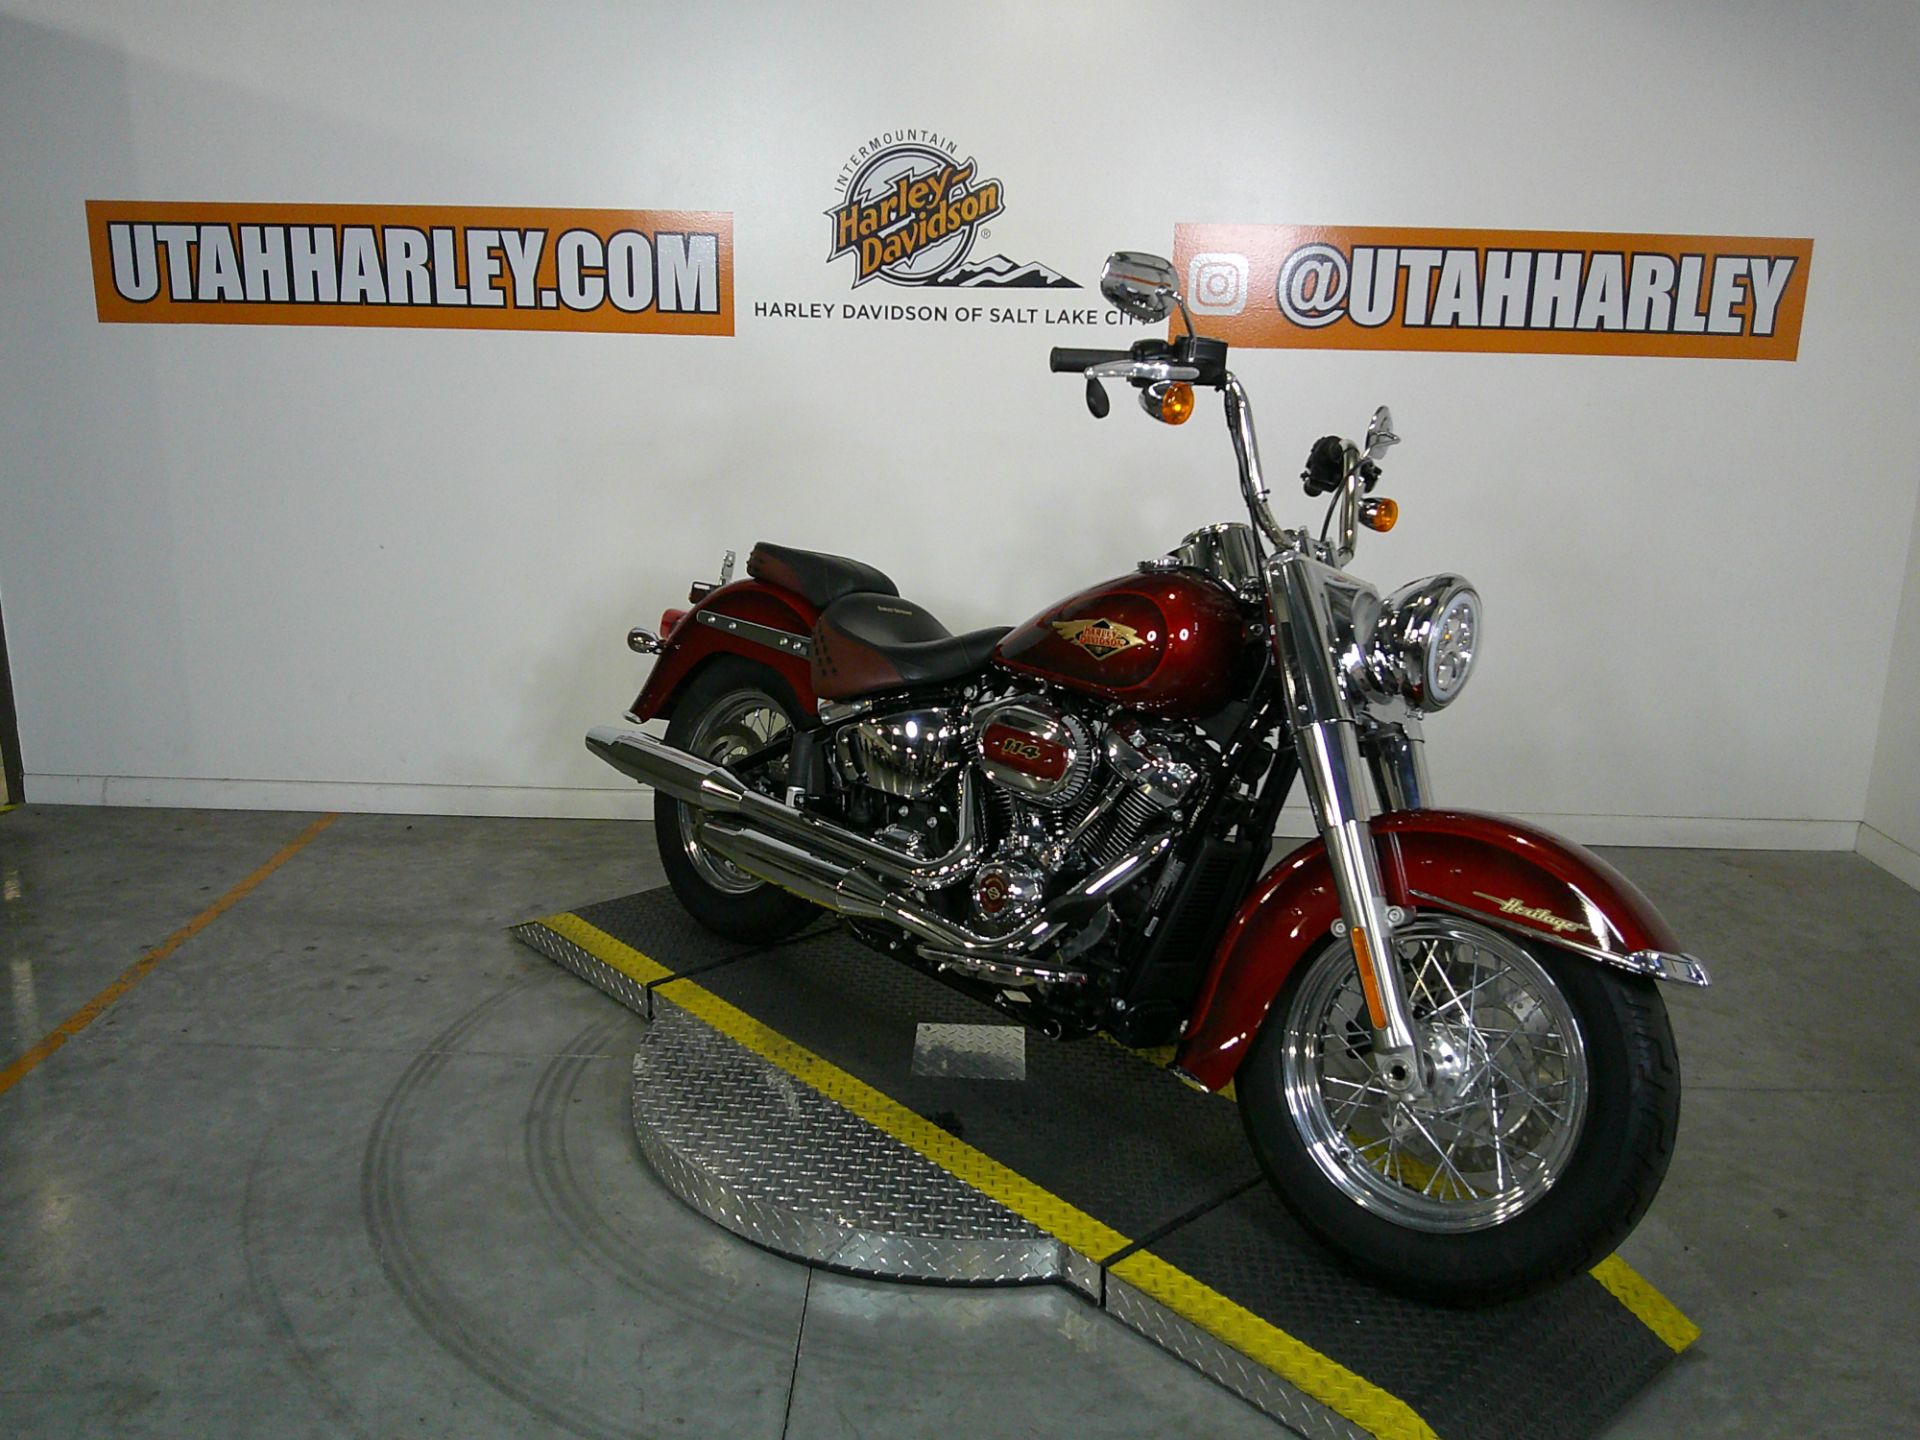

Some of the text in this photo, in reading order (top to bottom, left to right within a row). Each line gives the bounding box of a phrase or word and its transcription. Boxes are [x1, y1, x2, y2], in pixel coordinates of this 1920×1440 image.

[834, 129, 958, 193] INTERMOUNTAIN
[861, 185, 997, 276] Davidson
[106, 220, 721, 315] UTAHHARLEY.COM
[1275, 242, 1798, 337] @UTAHHARLEY
[754, 301, 1146, 326] HARLEY DAVIDSON OF SALT LAKE CI
[1001, 737, 1041, 760] 114
[1499, 897, 1580, 932] Heritage
